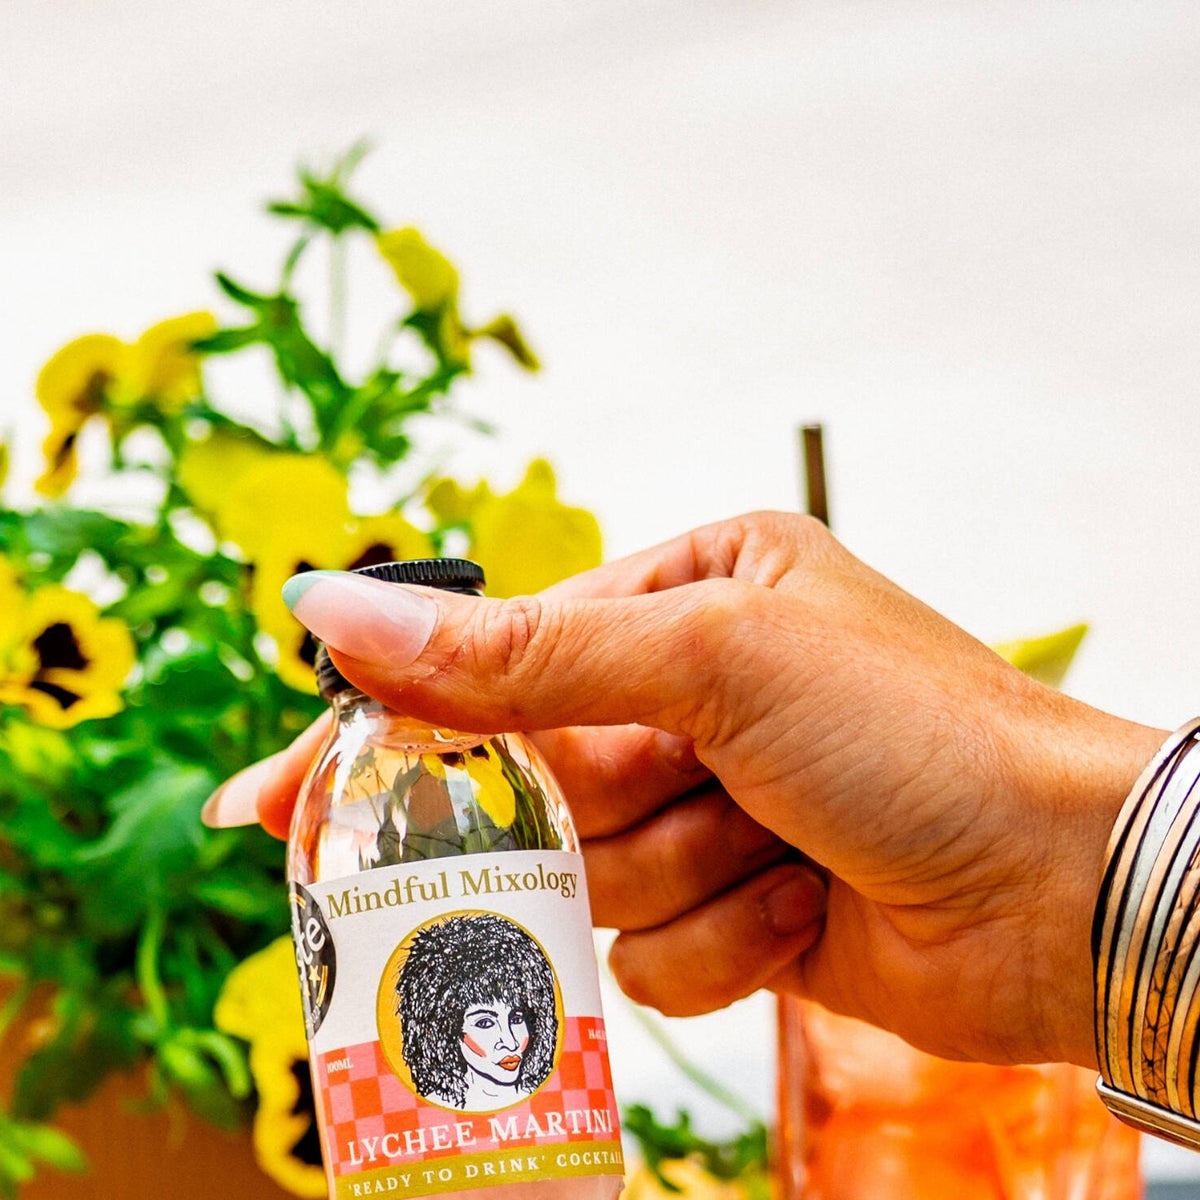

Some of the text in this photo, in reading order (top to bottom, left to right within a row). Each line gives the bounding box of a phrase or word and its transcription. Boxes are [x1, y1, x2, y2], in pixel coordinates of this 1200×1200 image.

[326, 863, 577, 920] Mindful Mixology
[347, 1109, 613, 1166] LYCHEE MARTINI
[422, 1168, 453, 1184] TO
